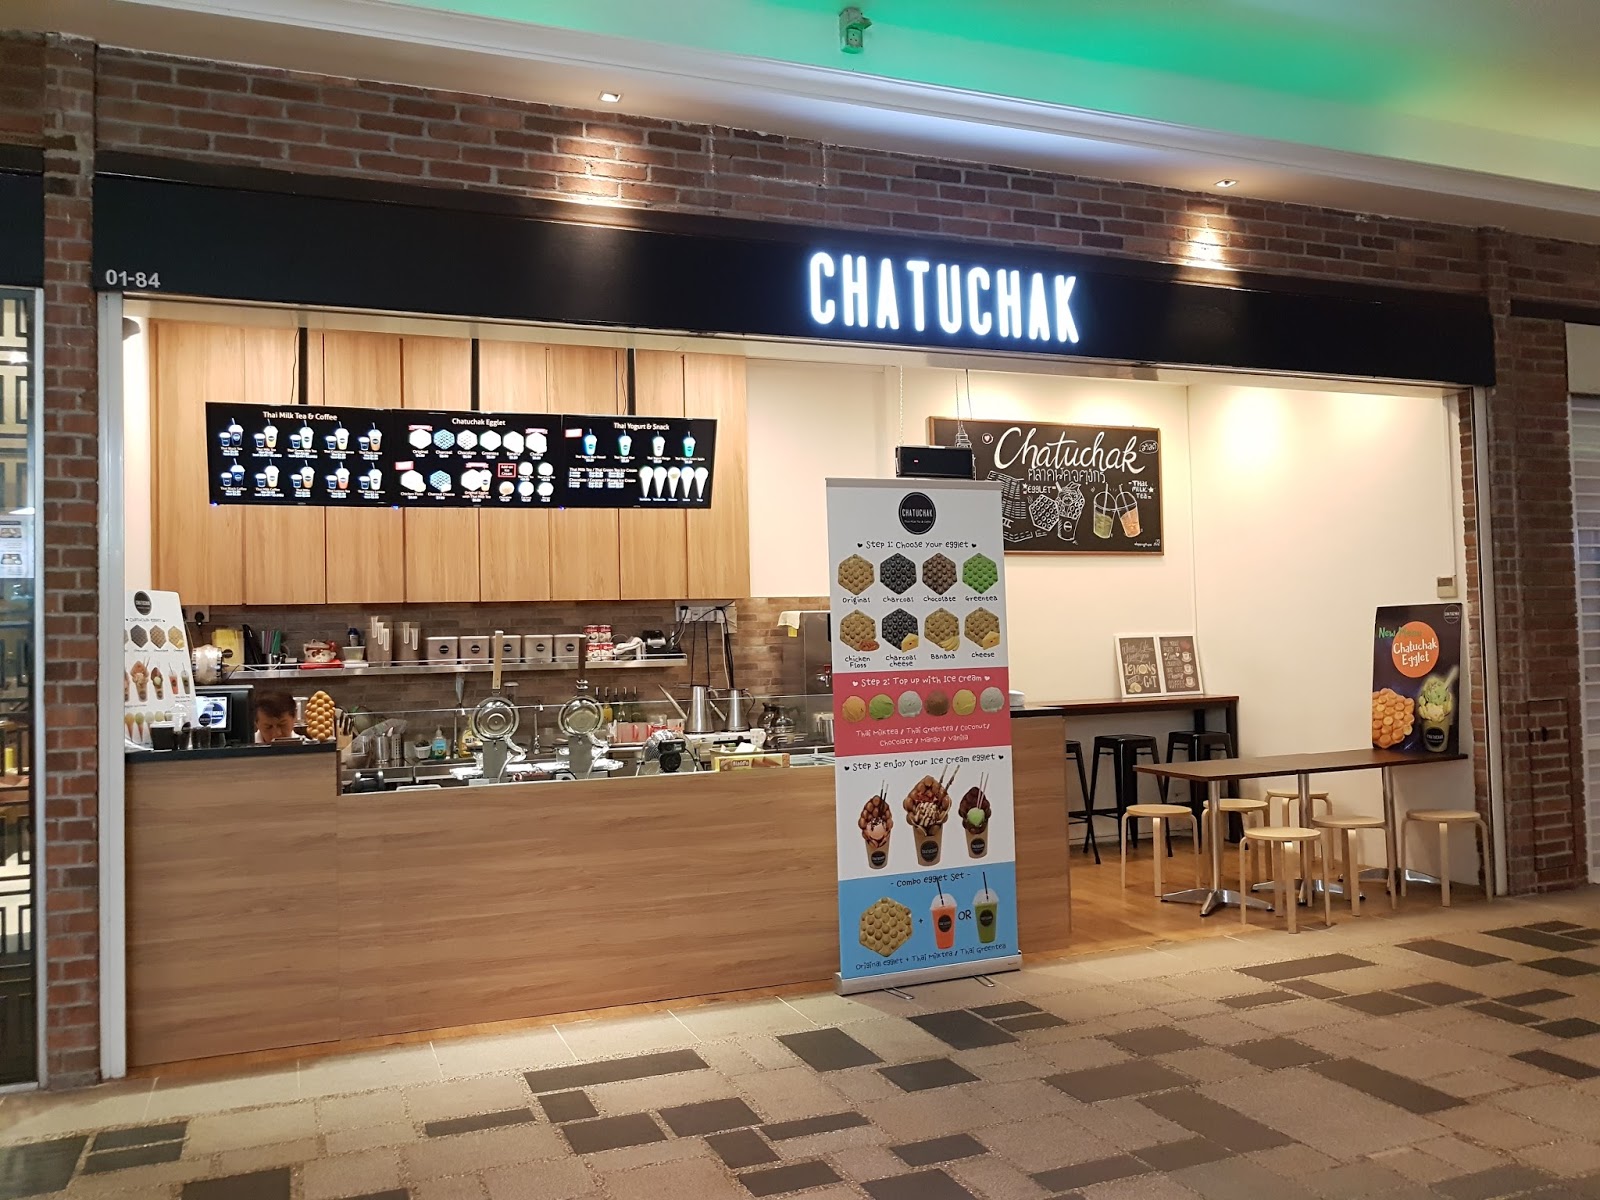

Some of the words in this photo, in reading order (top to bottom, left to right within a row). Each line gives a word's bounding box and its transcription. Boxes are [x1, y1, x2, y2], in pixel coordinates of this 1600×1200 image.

[105, 269, 161, 288] 01-84
[809, 252, 1080, 344] CHATUCHAK
[452, 418, 485, 426] Chatuchak
[486, 419, 506, 427] Egglet
[627, 423, 646, 431] Yogurt
[994, 426, 1146, 474] Chatuchak
[902, 508, 933, 517] CHATUCHAK
[866, 540, 885, 549] Step
[896, 541, 923, 549] Choose
[842, 597, 871, 605] Original
[1379, 627, 1396, 638] New
[1393, 638, 1438, 654] Chatuchak
[1402, 651, 1430, 668] Egglet
[861, 678, 880, 688] Step
[893, 677, 909, 685] Top
[922, 676, 941, 684] with
[852, 761, 872, 772] Step
[930, 757, 944, 765] Ice
[896, 878, 921, 888] Combo
[958, 910, 972, 920] OR
[855, 961, 882, 970] Original
